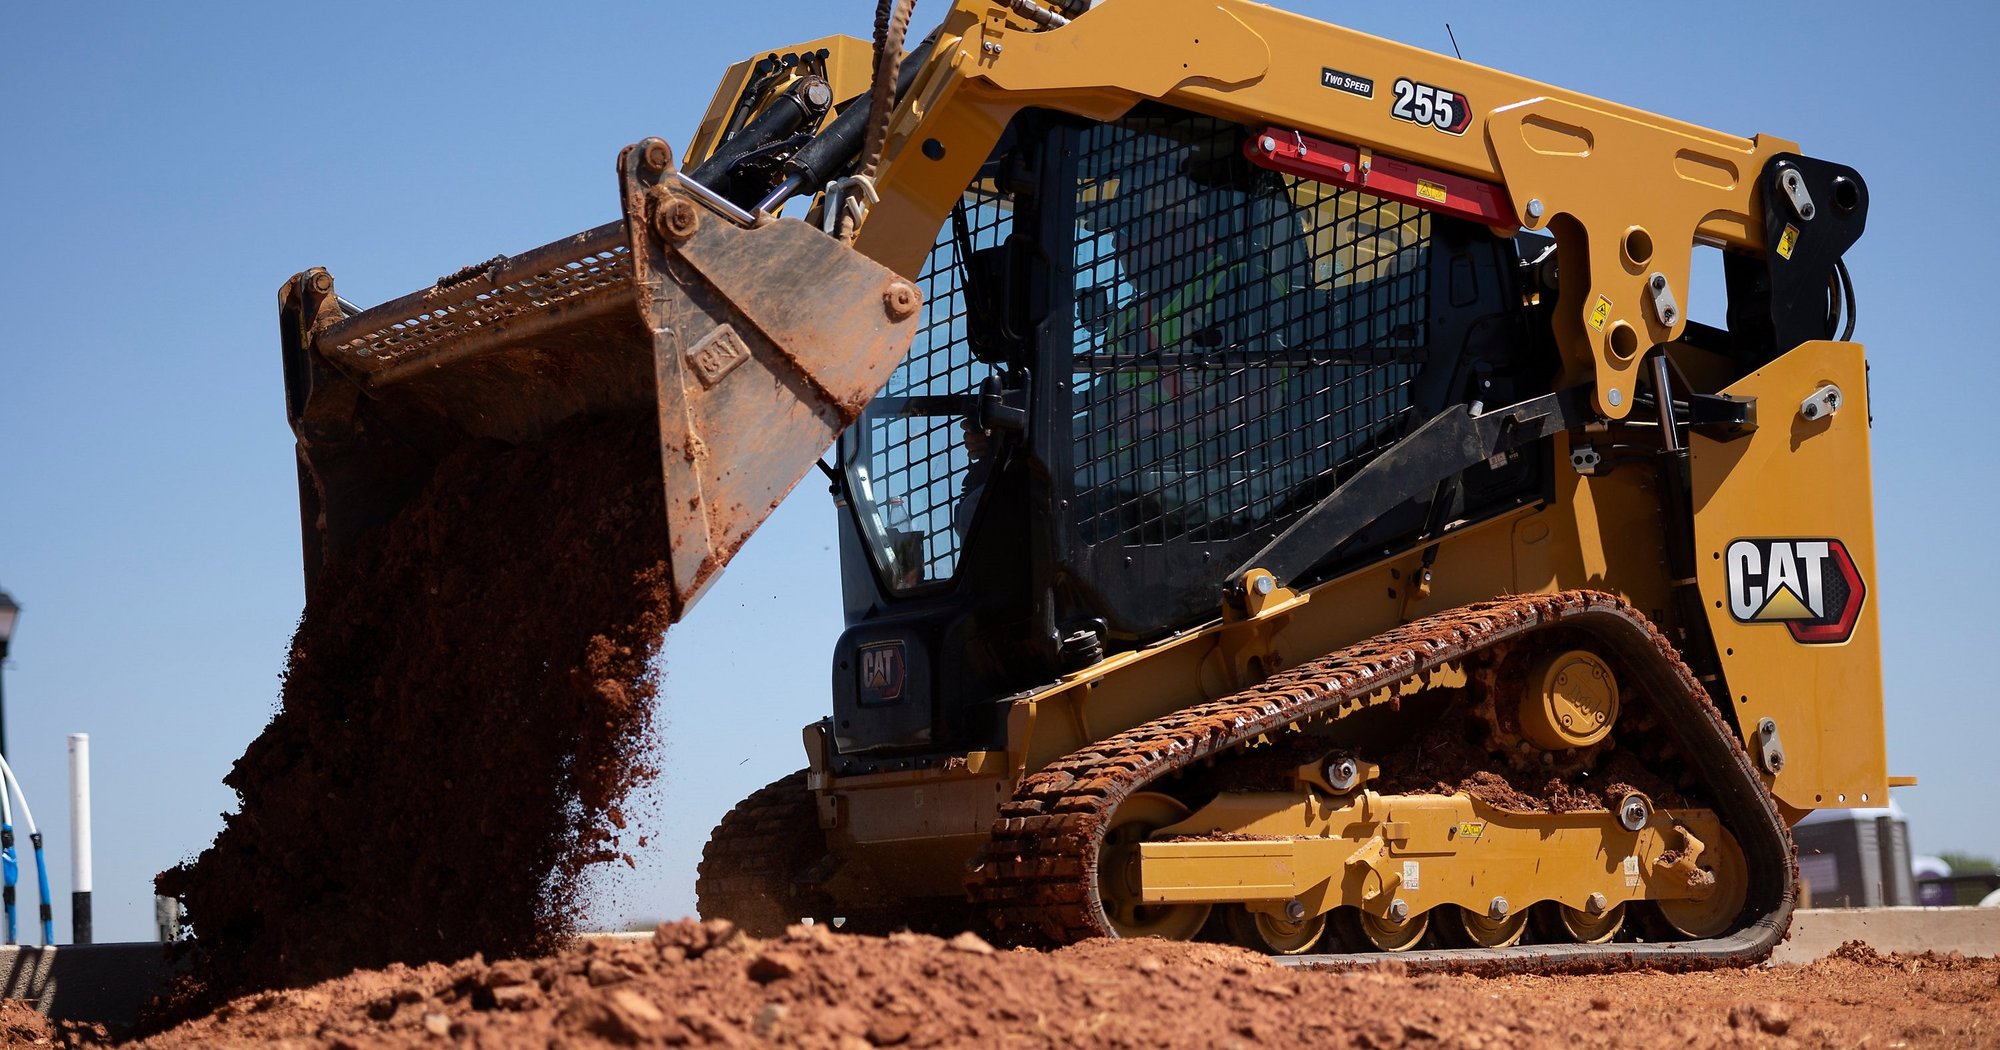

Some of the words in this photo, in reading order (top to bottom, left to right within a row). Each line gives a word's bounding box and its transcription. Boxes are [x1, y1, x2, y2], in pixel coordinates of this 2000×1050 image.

[1393, 79, 1454, 128] 255
[700, 332, 740, 375] CAT
[1727, 541, 1829, 620] CAT
[863, 649, 893, 688] CAT
